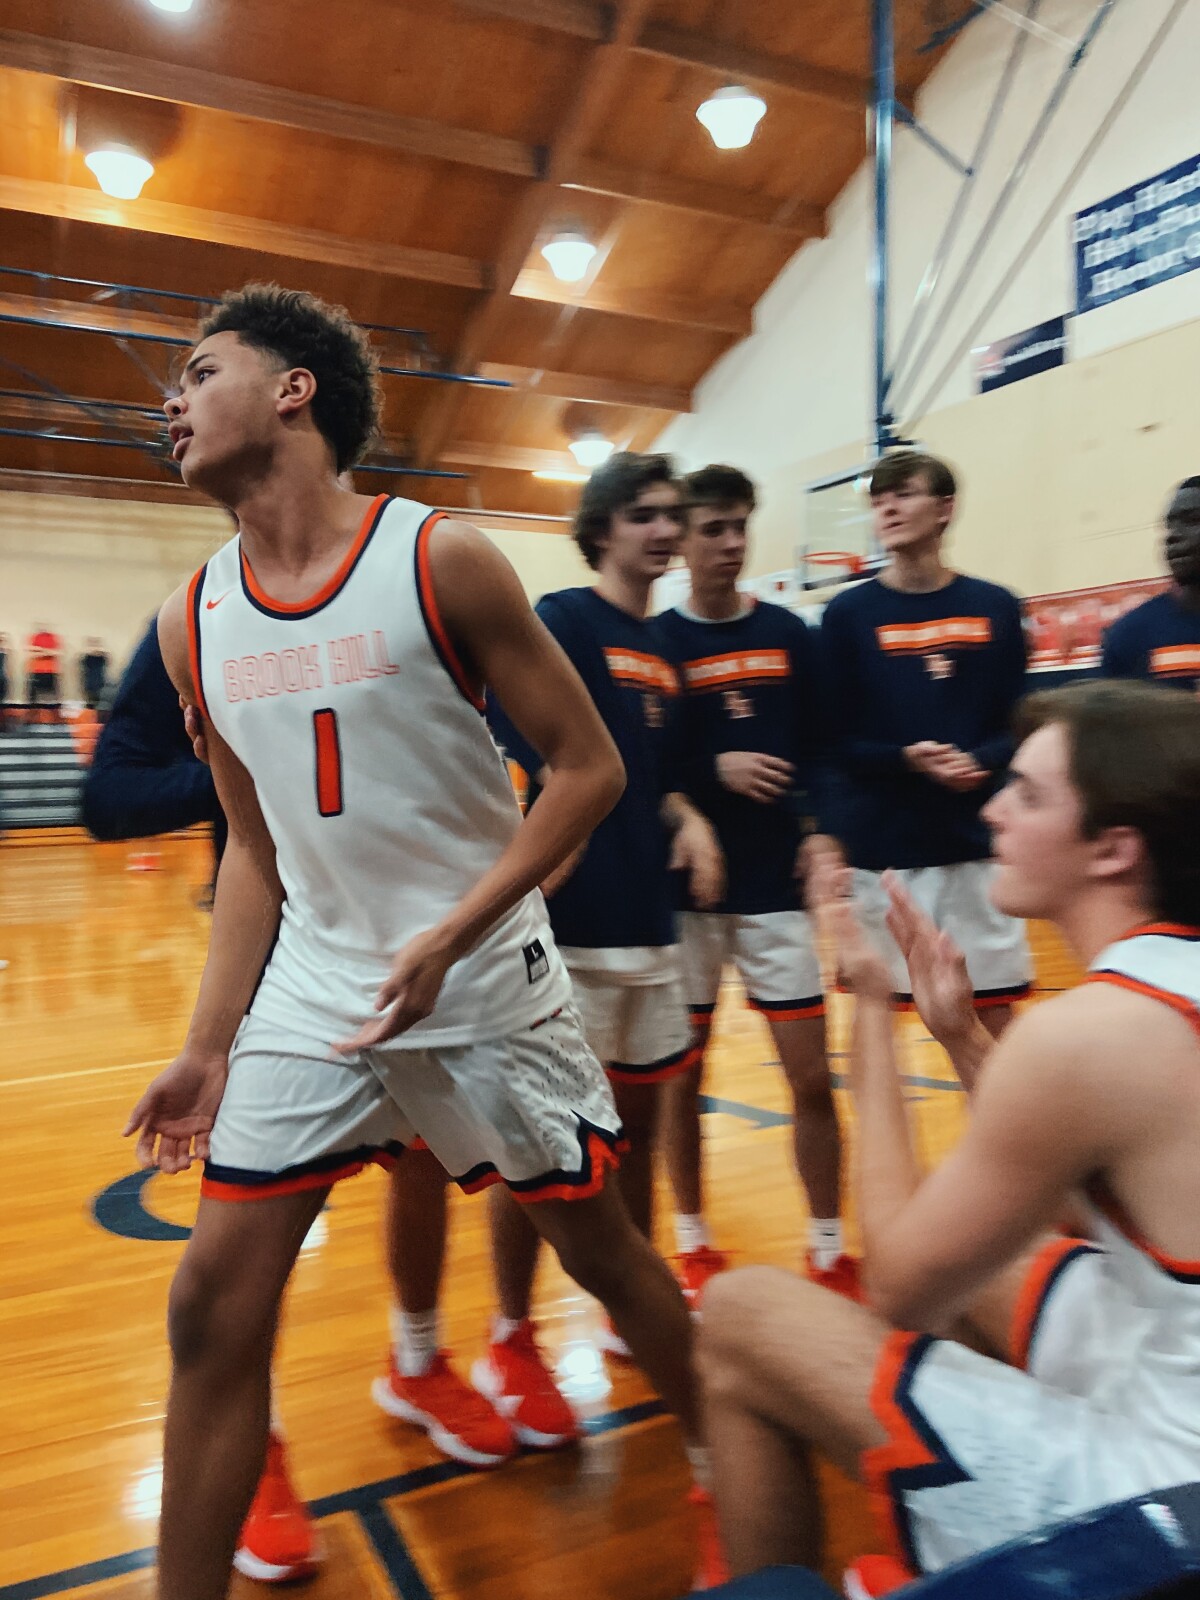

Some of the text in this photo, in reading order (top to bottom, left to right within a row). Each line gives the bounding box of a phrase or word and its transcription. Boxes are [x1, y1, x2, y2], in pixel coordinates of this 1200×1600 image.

[223, 630, 399, 702] BROOK HILL
[312, 707, 343, 817] 1
